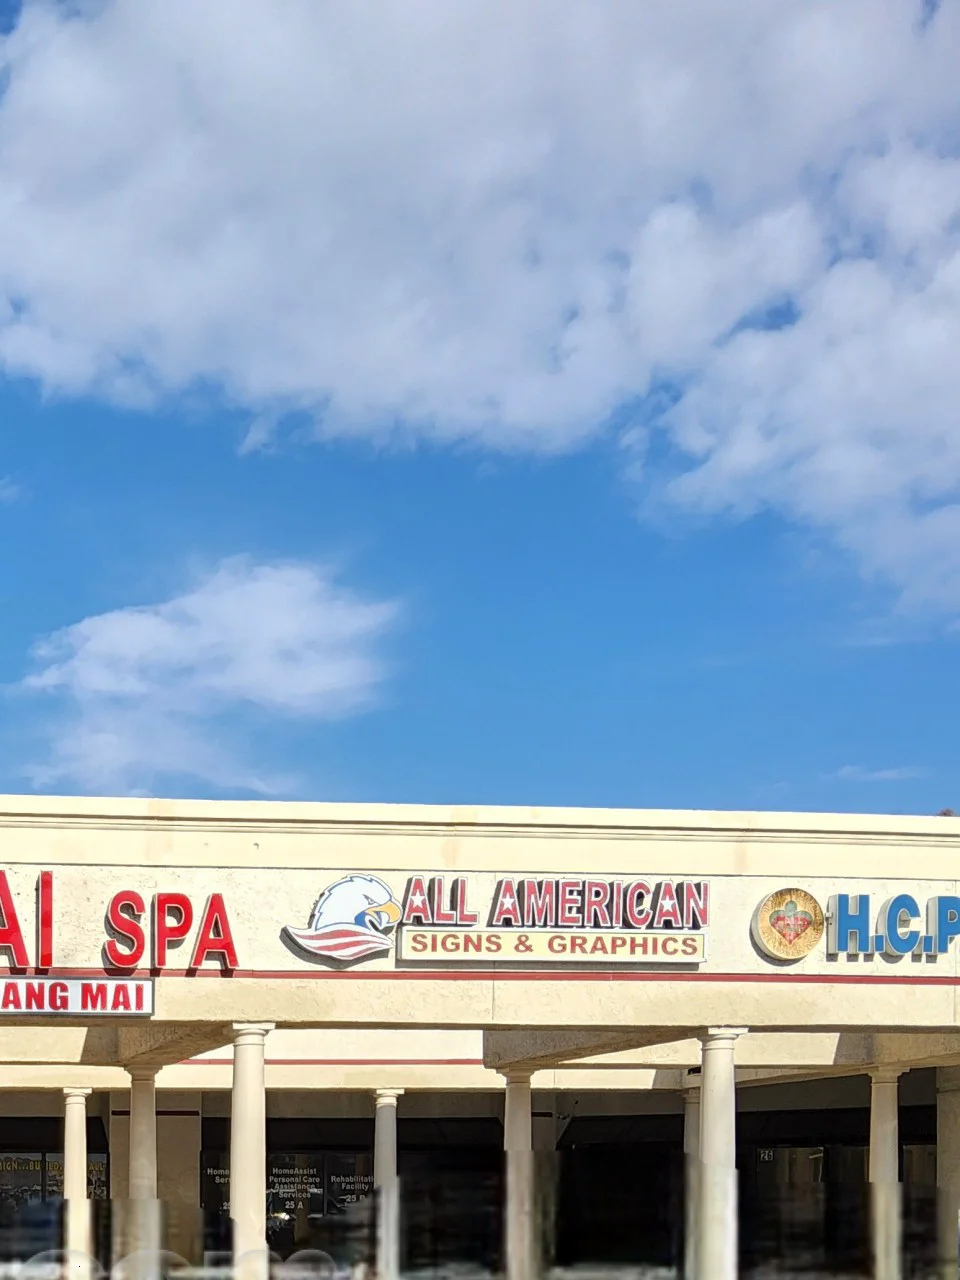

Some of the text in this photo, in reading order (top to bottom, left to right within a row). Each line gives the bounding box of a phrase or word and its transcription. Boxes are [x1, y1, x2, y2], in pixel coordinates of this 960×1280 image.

[403, 875, 710, 928] ALL AMERICAN
[103, 890, 240, 968] SPA
[410, 933, 699, 956] SIGNS & GRAPHICS
[80, 982, 145, 1012] MAI
[760, 1150, 773, 1161] 26
[269, 1175, 320, 1183] Personal Care
[341, 1182, 369, 1191] Facility
[278, 1191, 311, 1199] Services
[345, 1194, 357, 1202] 25
[284, 1201, 304, 1209] 25 A
